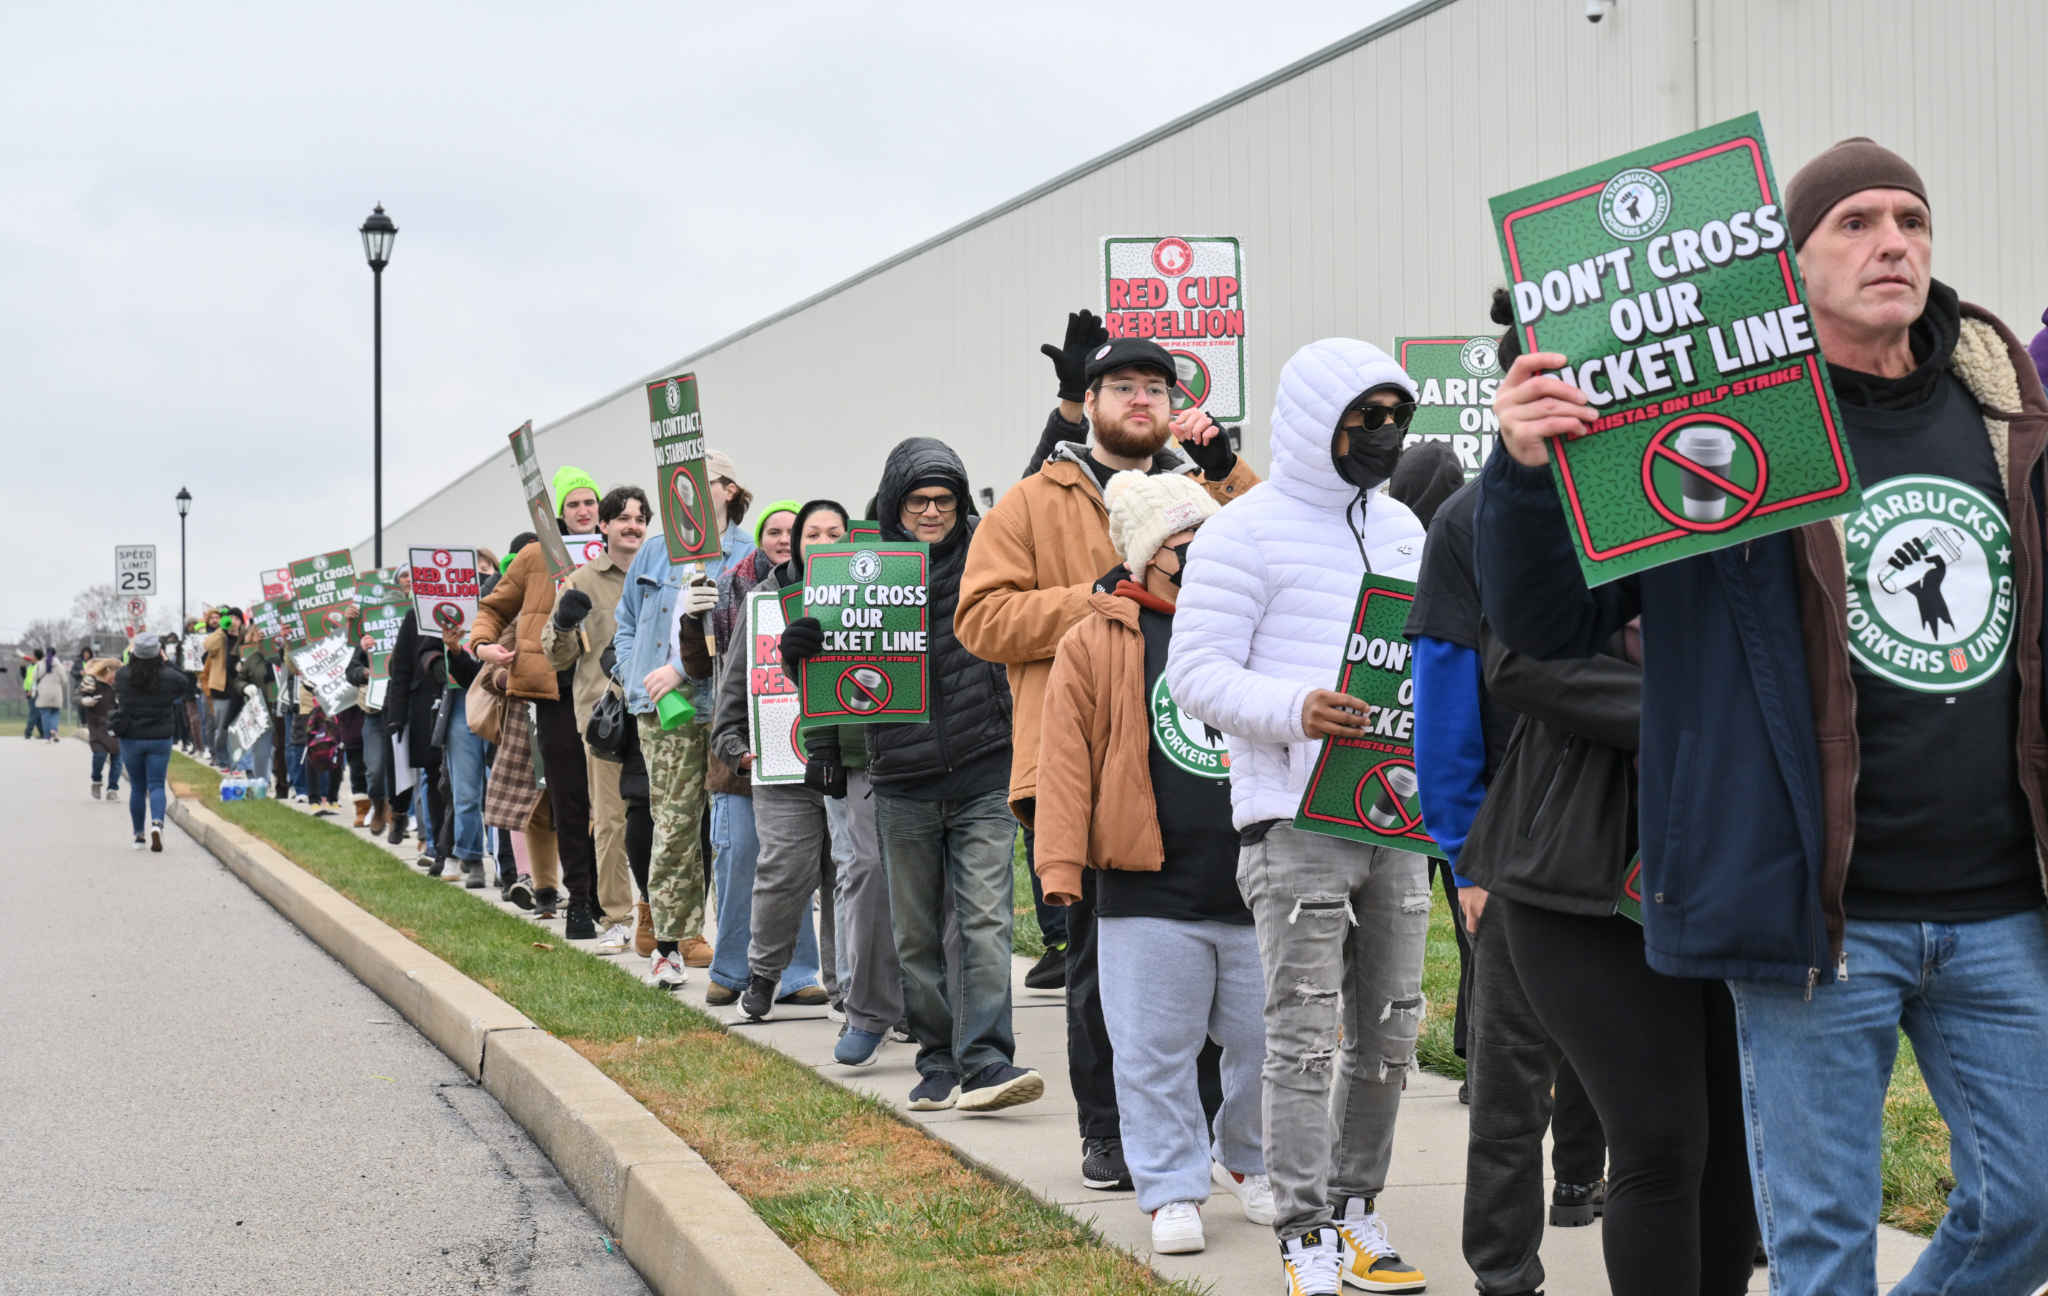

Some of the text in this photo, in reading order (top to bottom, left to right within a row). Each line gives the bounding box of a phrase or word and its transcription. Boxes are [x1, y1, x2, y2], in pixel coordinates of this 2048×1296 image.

[1605, 173, 1657, 200] STARBUCKS
[1604, 194, 1666, 236] WORKERS UNITED
[1513, 204, 1786, 325] DON'T CROSS
[1109, 276, 1239, 309] RED CUP
[1609, 281, 1706, 342] OUR
[1105, 309, 1244, 339] REBELLION
[1463, 356, 1483, 374] WORKERS
[1545, 303, 1815, 406] ICKET LINE
[1661, 395, 1690, 414] ON
[1691, 384, 1730, 406] ULP
[1732, 365, 1802, 396] STRIKE
[651, 411, 702, 440] NO CONTRACT,
[1459, 407, 1500, 432] ON
[655, 437, 705, 467] NO STARBUCKS!
[1846, 490, 2000, 549] STARBUCKS
[119, 551, 153, 560] SPEED
[122, 561, 149, 570] LIMIT
[853, 551, 878, 562] STARBUCKS
[121, 572, 151, 590] 25
[293, 572, 321, 588] DON'T
[323, 565, 354, 578] CROSS
[412, 566, 441, 582] RED
[445, 568, 476, 583] CUP
[315, 580, 336, 593] OUR
[412, 581, 480, 597] REBELLION
[804, 584, 927, 607] DON'T CROSS
[298, 592, 335, 610] PICKET
[841, 607, 883, 629] OUR
[1845, 574, 2012, 674] WORKERS UNITED
[821, 631, 927, 652] CKET LINE
[305, 645, 347, 676] CONTRACT
[311, 648, 329, 661] NO
[808, 655, 853, 663] BARISTAS
[326, 664, 344, 679] NO
[1158, 711, 1218, 768] WORKERS
[1336, 738, 1412, 756] BARISTAS ON
